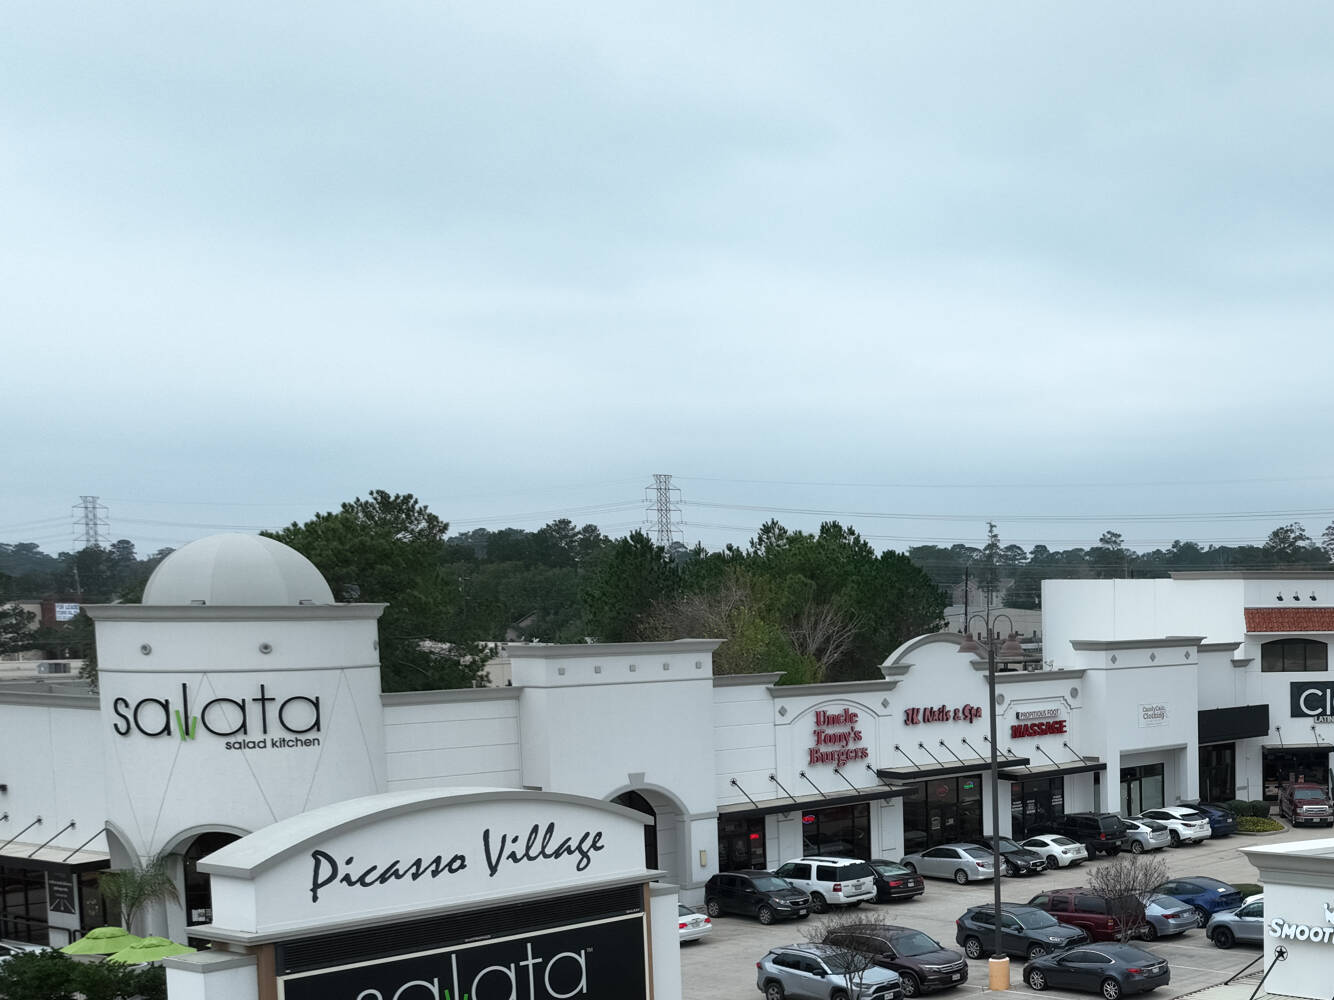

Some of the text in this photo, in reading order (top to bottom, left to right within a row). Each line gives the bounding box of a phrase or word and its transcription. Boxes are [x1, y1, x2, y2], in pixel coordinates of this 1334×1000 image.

[112, 683, 321, 741] salata
[814, 706, 860, 727] Uncle
[903, 703, 983, 727] JK Nails & Spa
[1314, 714, 1334, 723] LATIN
[812, 727, 863, 749] Tony's
[1010, 719, 1068, 739] MASSAGE
[224, 734, 321, 751] salad kitchen
[808, 747, 869, 769] Burgers
[309, 821, 605, 903] Picasso Village
